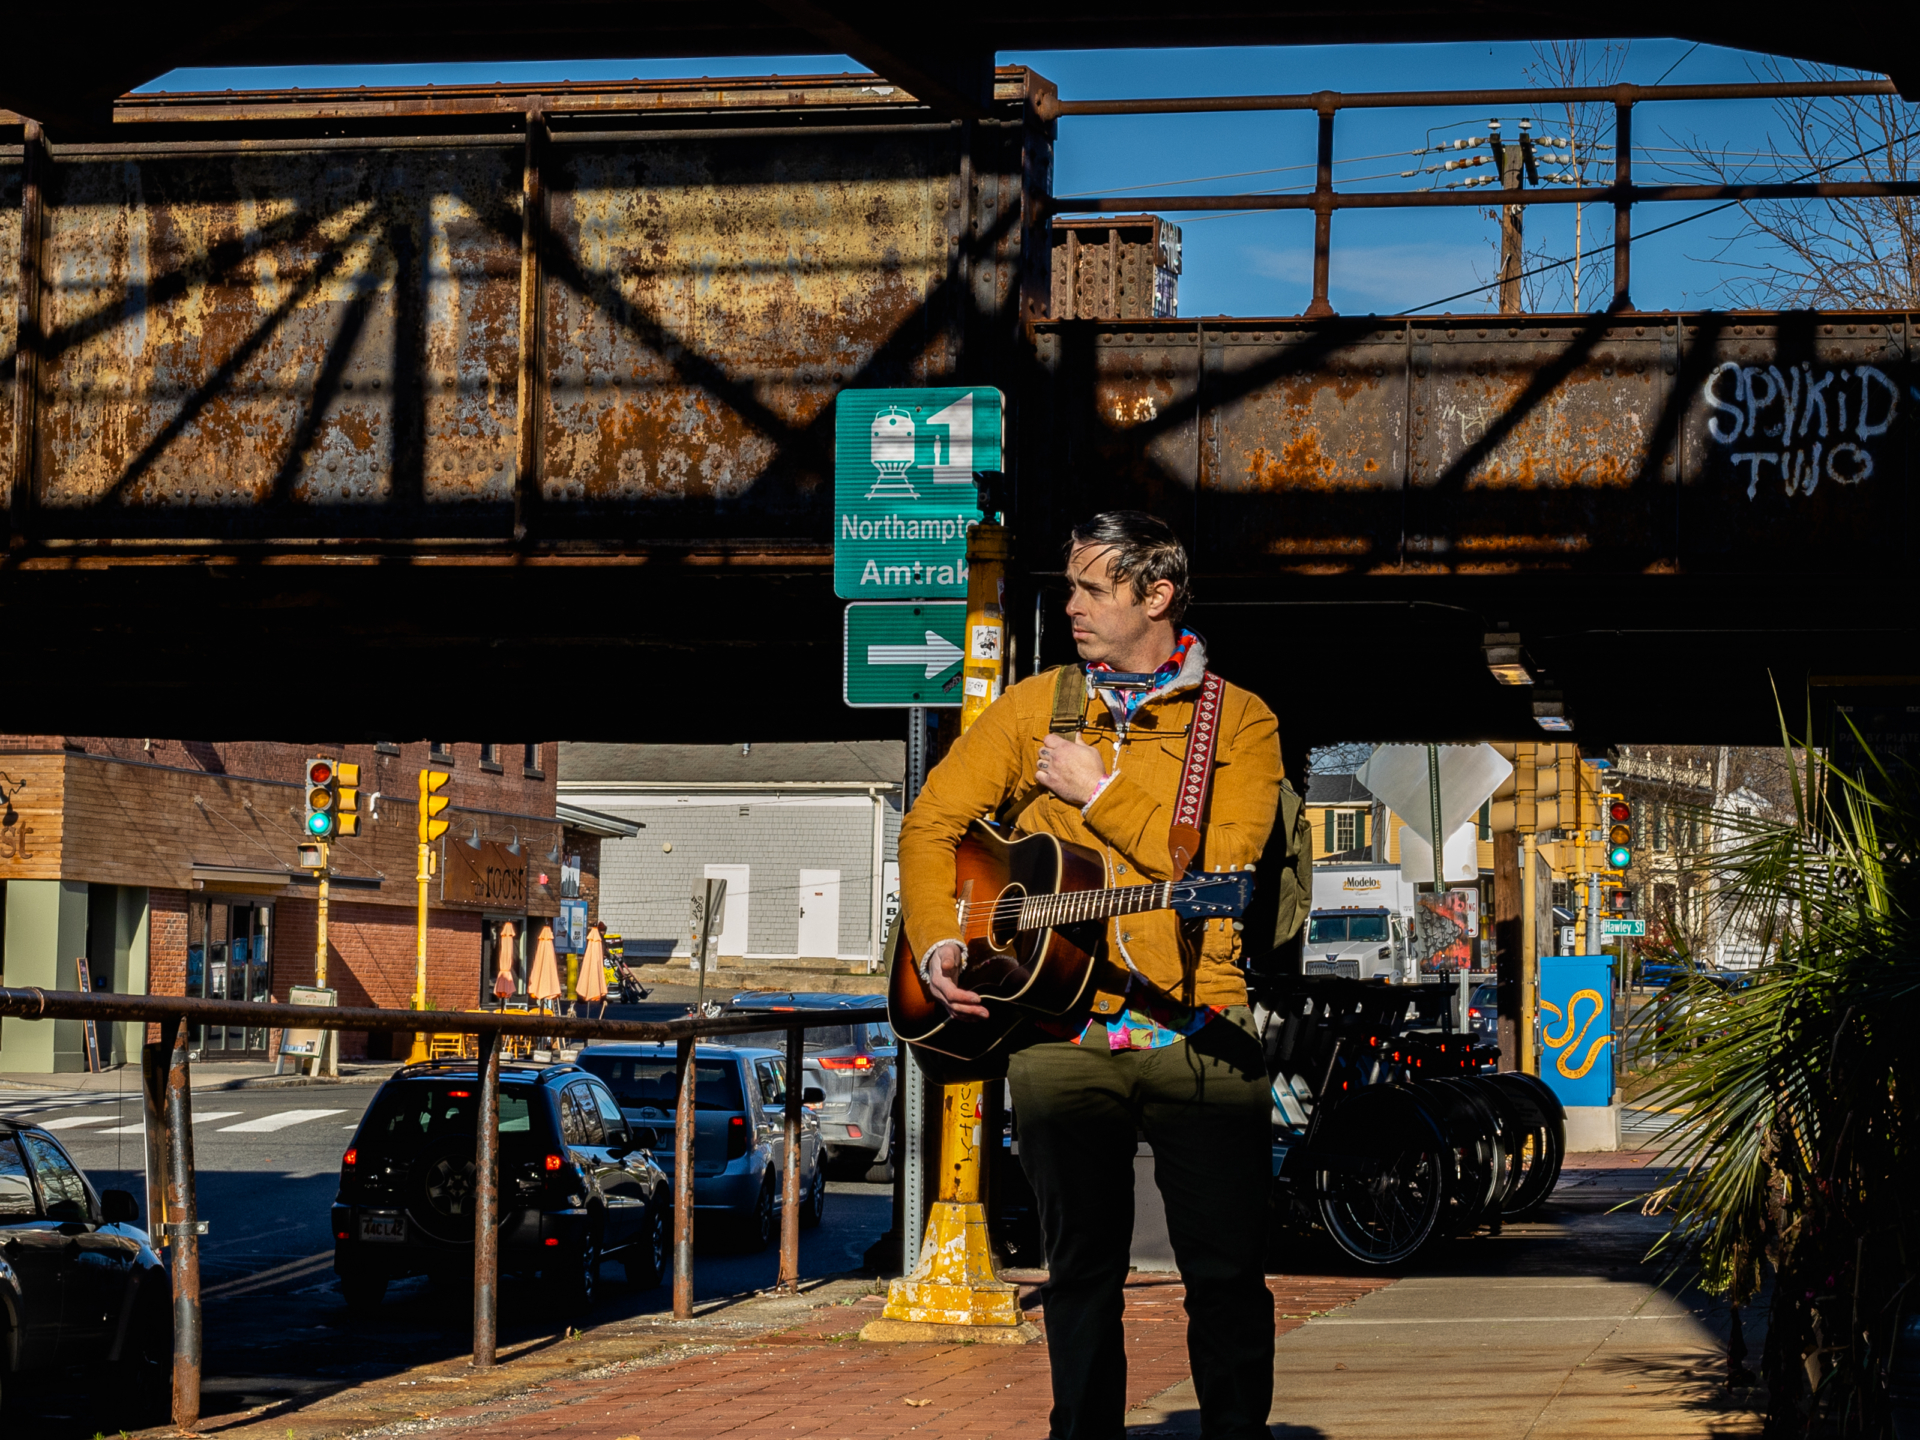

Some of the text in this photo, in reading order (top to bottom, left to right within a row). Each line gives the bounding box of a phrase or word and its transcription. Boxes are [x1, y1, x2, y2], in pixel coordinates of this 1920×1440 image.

[1730, 441, 1873, 501] TWO
[860, 558, 969, 585] Amtrak
[486, 865, 524, 900] roost
[1347, 877, 1376, 887] Modelo
[1605, 921, 1643, 935] Hawley St
